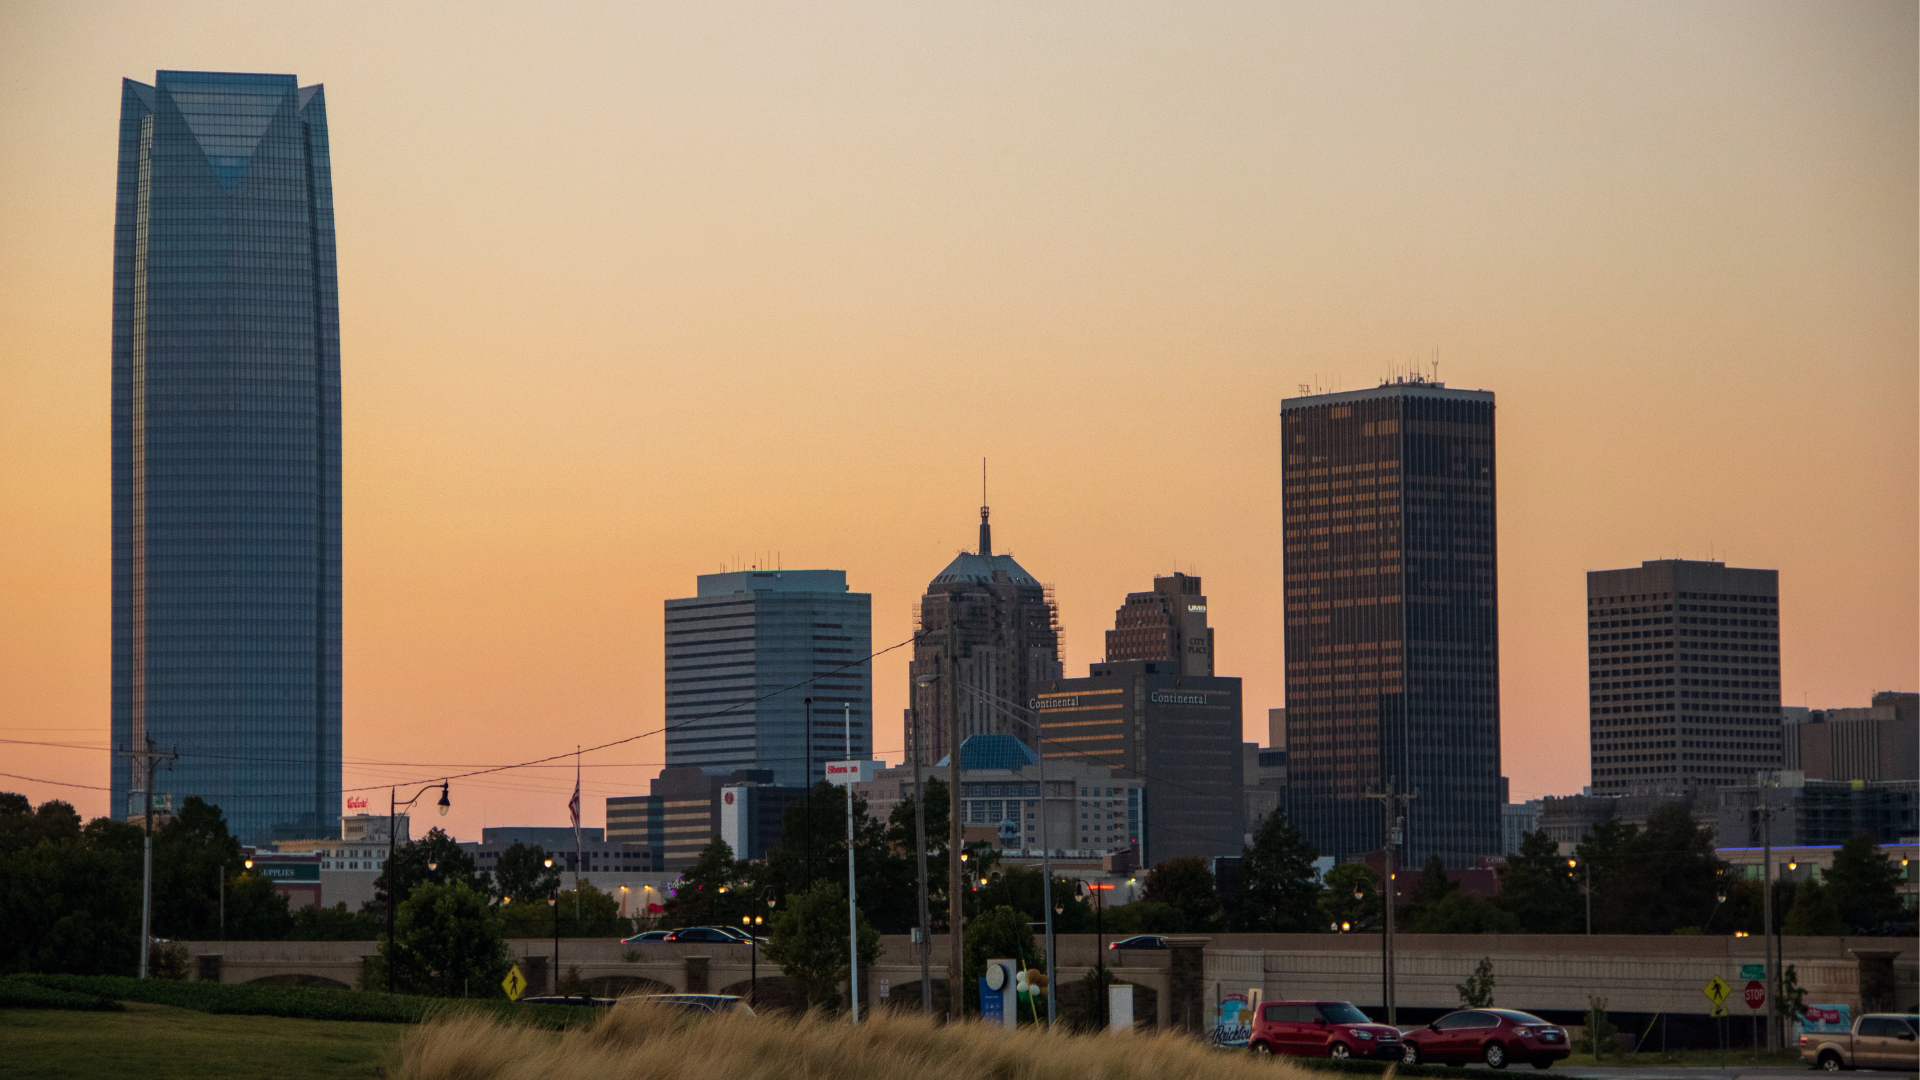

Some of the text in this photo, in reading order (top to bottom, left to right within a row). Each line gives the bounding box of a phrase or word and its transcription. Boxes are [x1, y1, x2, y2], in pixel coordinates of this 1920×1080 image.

[1187, 604, 1206, 613] UMB
[1189, 637, 1205, 645] CITY
[1188, 646, 1207, 654] PLACE
[1029, 695, 1079, 709] Continental
[1151, 691, 1207, 704] Continental
[827, 765, 858, 774] Sheraon
[1745, 988, 1765, 1001] STOP
[1822, 1012, 1839, 1021] WAY
